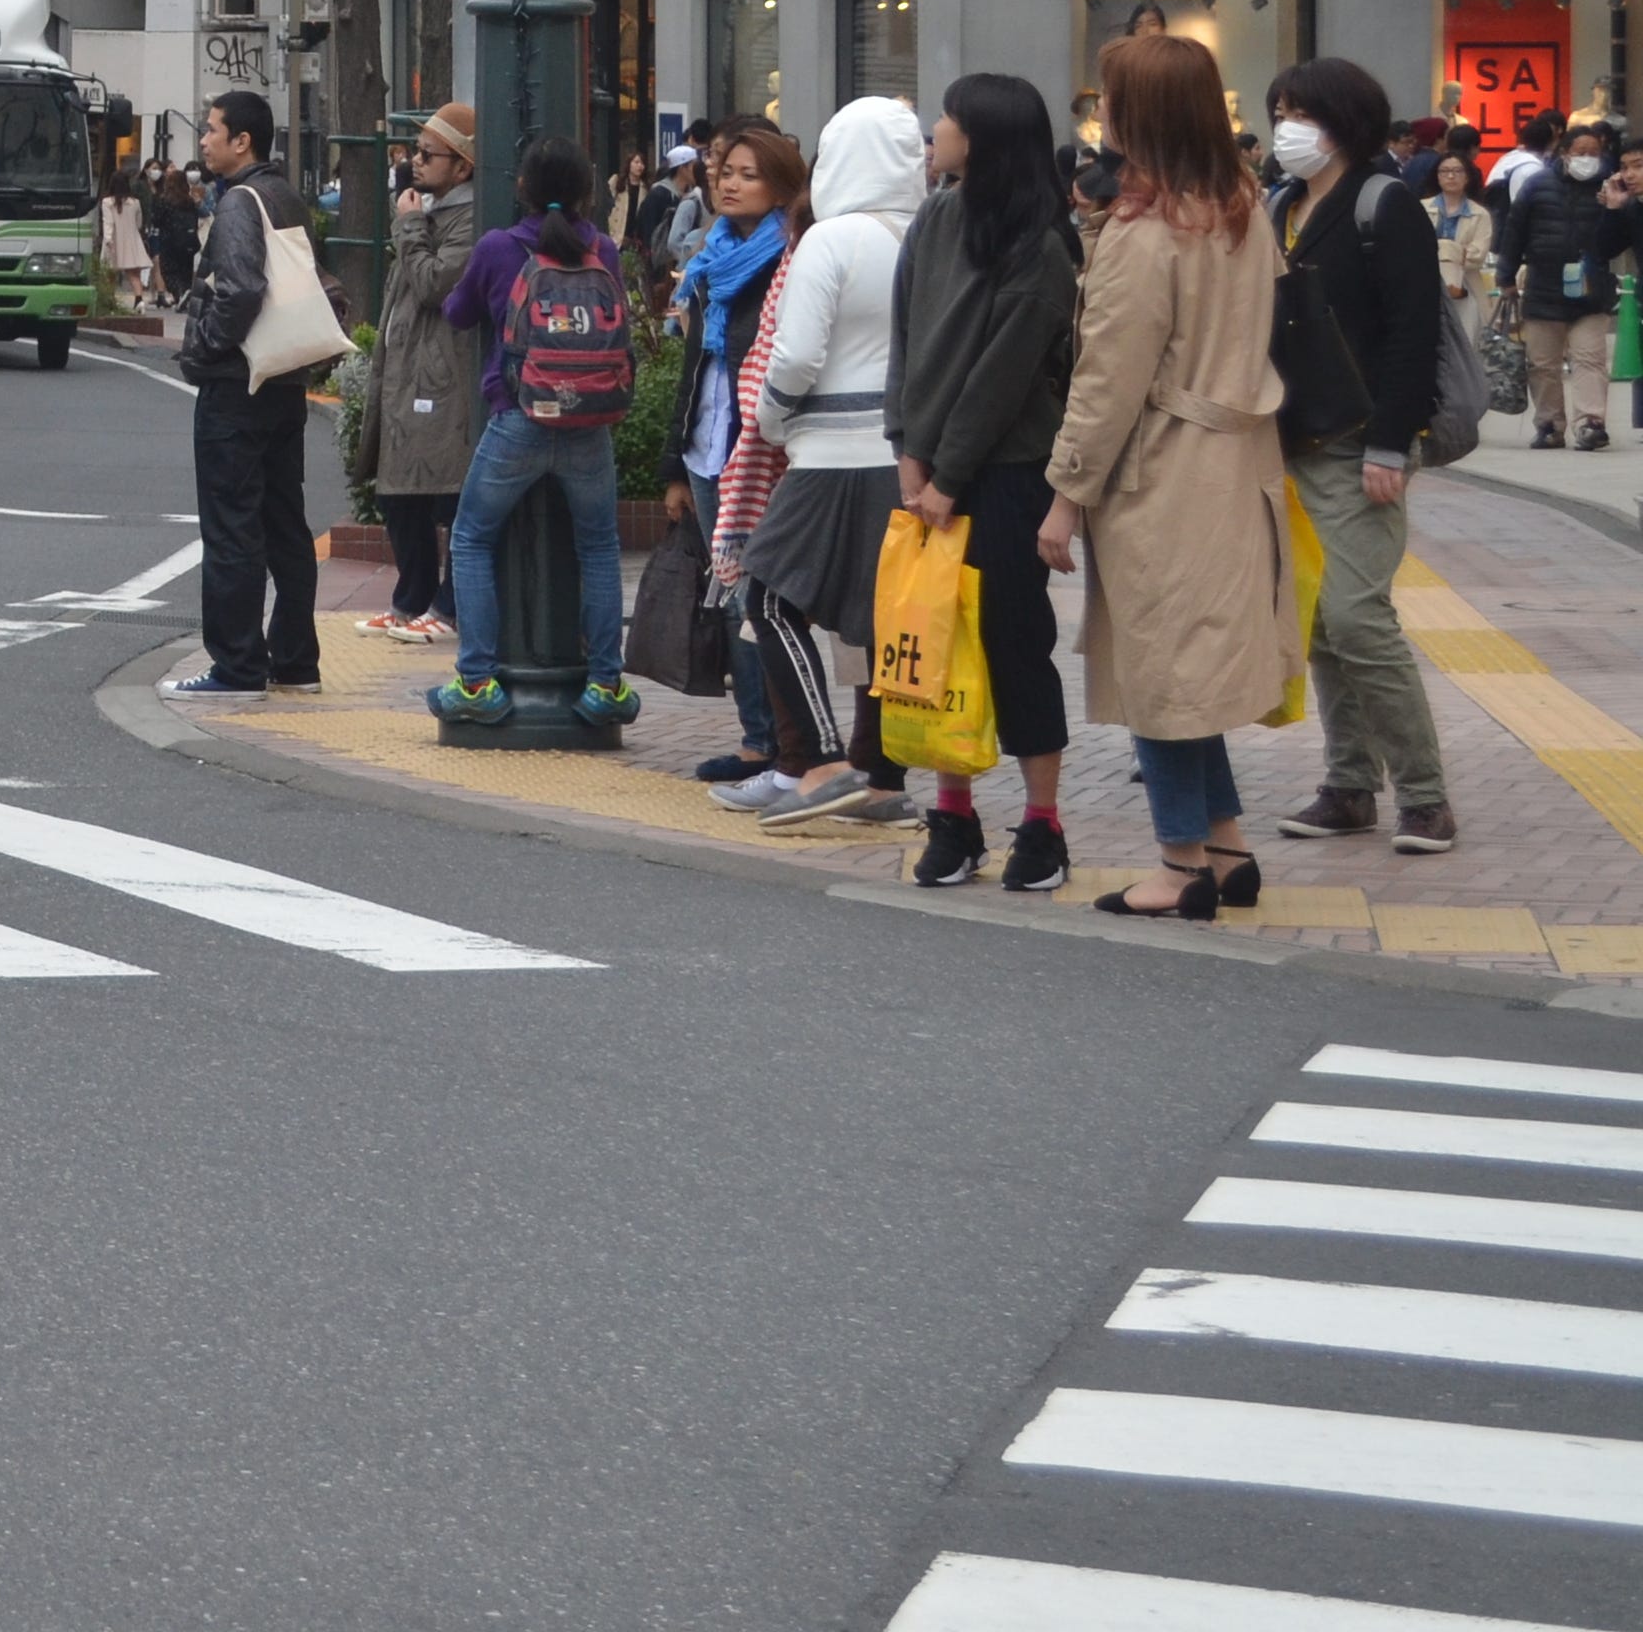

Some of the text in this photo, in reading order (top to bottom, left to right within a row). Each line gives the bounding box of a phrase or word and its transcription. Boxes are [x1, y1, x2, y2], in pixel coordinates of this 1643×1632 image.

[1475, 58, 1541, 92] SA
[1479, 101, 1538, 136] LE
[573, 305, 590, 335] 9
[944, 690, 966, 713] 21
